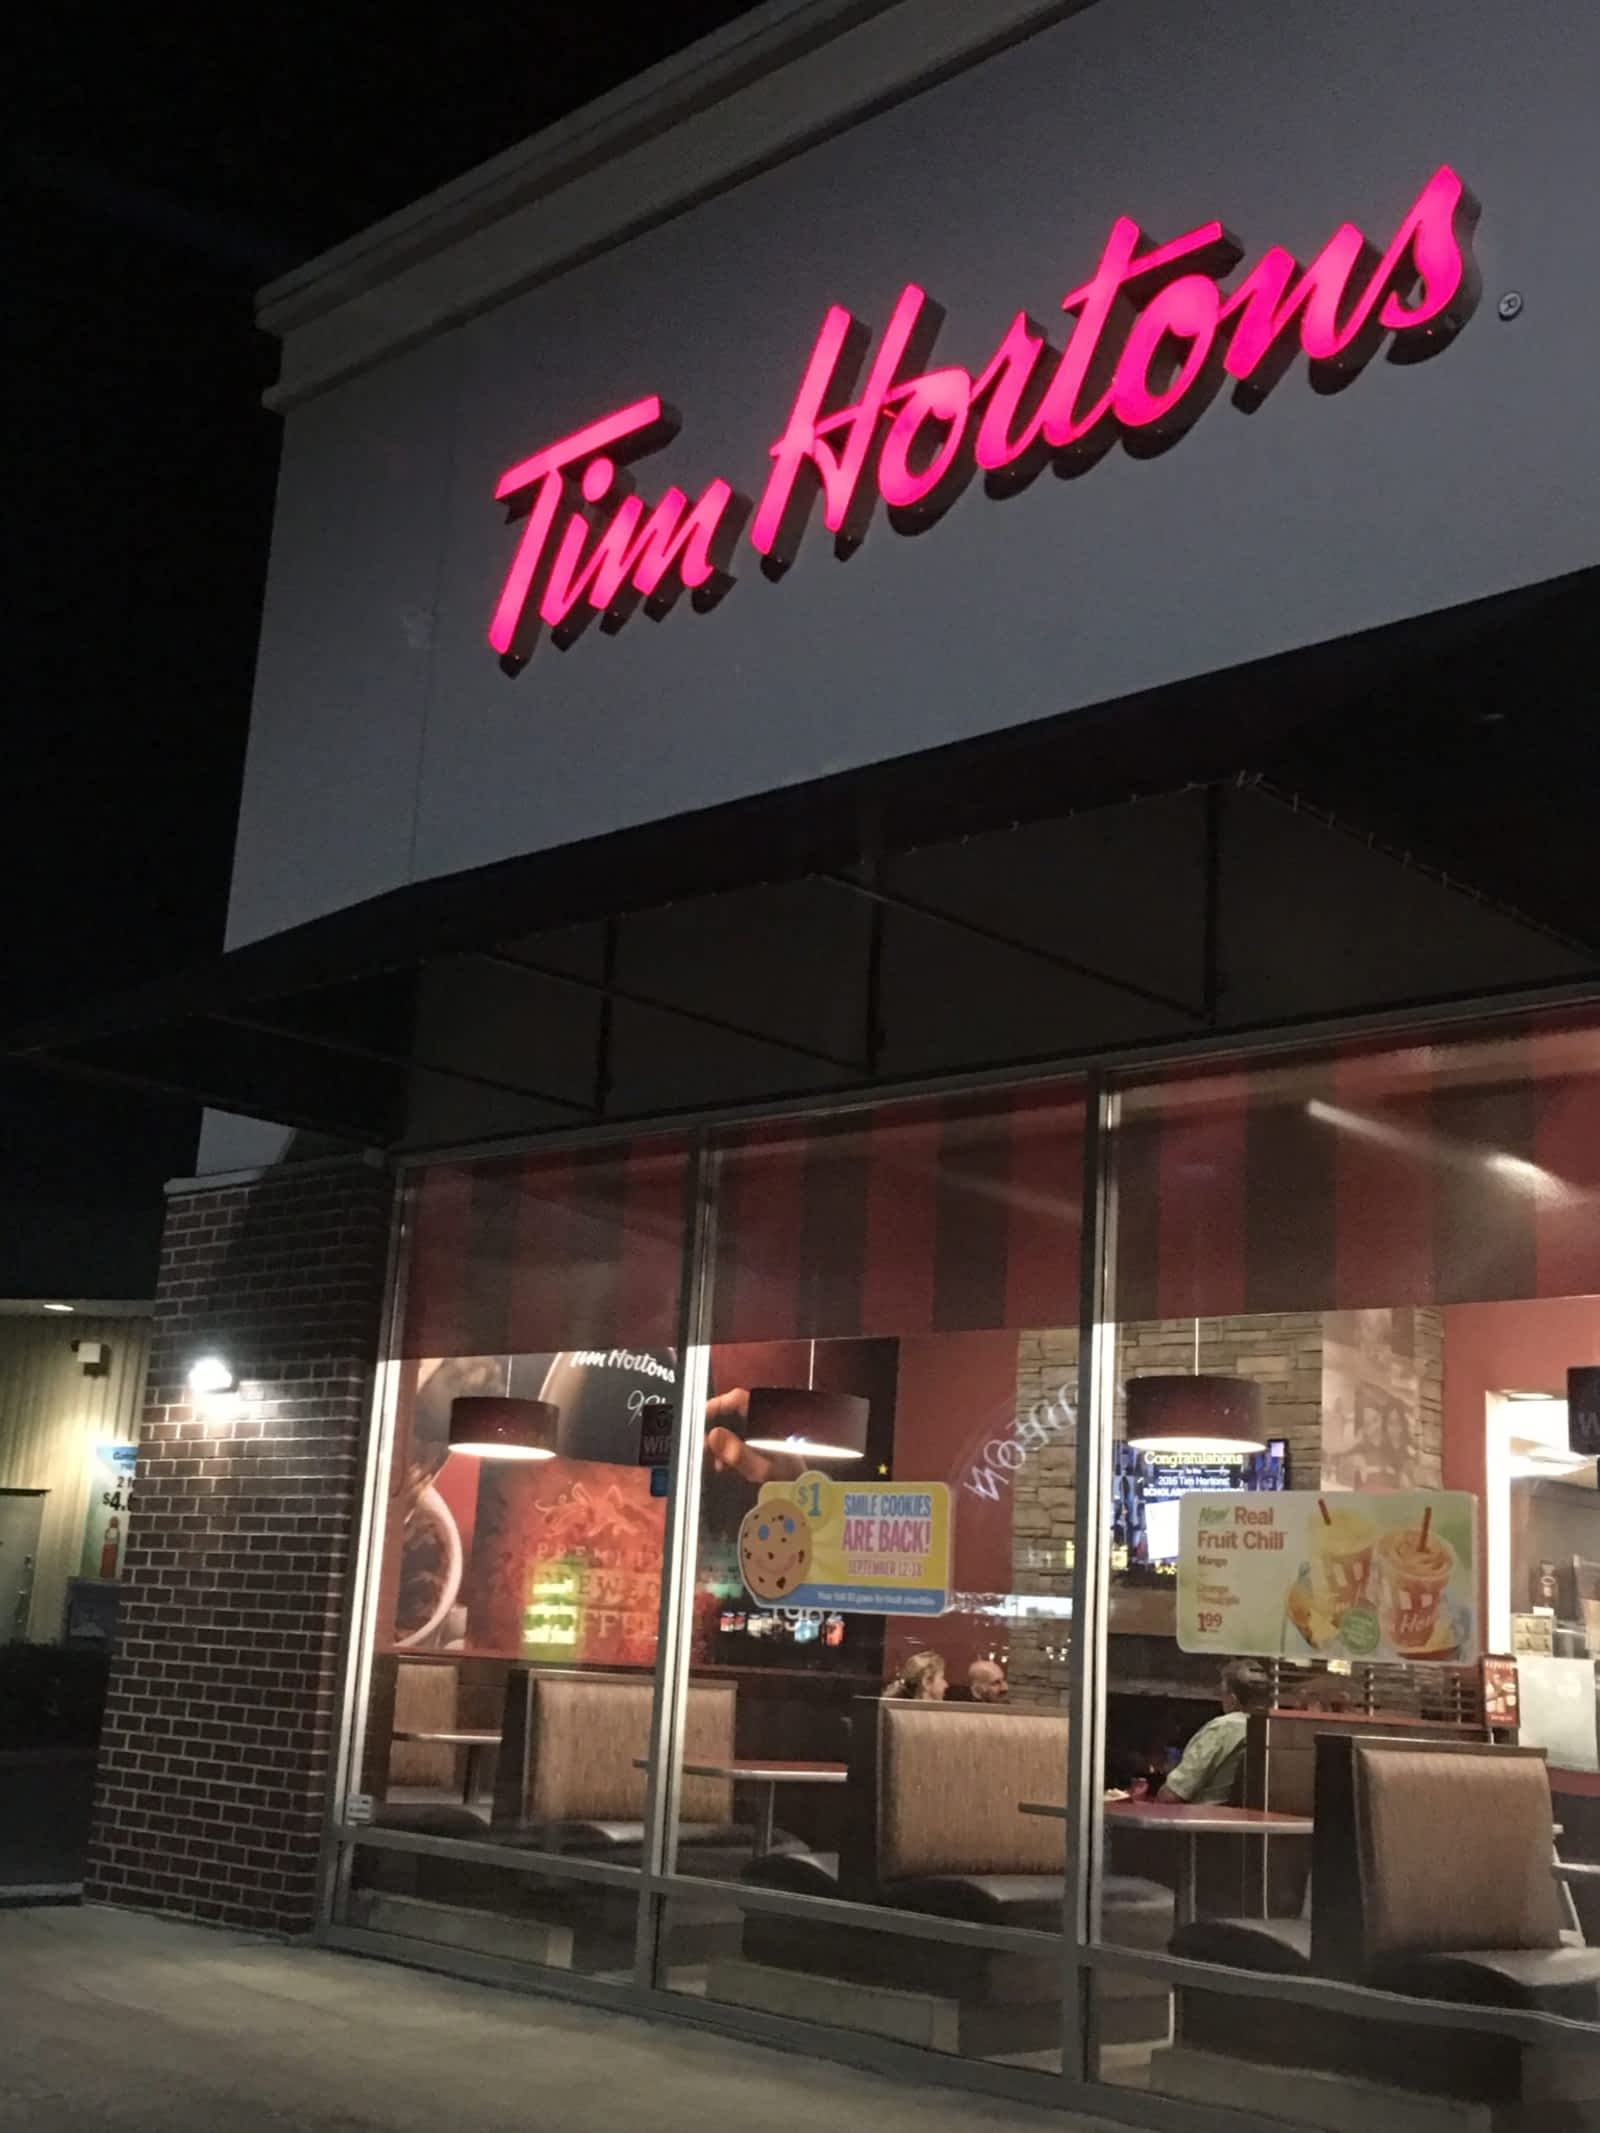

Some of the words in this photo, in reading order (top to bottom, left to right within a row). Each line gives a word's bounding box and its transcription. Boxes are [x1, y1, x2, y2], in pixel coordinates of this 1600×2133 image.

[487, 395, 732, 655] Tim
[749, 164, 1464, 556] Hortons
[607, 1348, 676, 1383] Hortons
[844, 1494, 877, 1516] SMILE
[880, 1495, 932, 1517] COOKIES
[1234, 1506, 1274, 1526] Real
[843, 1519, 876, 1552] ARE
[879, 1519, 932, 1554] BACK!
[1198, 1530, 1238, 1549] Fruit
